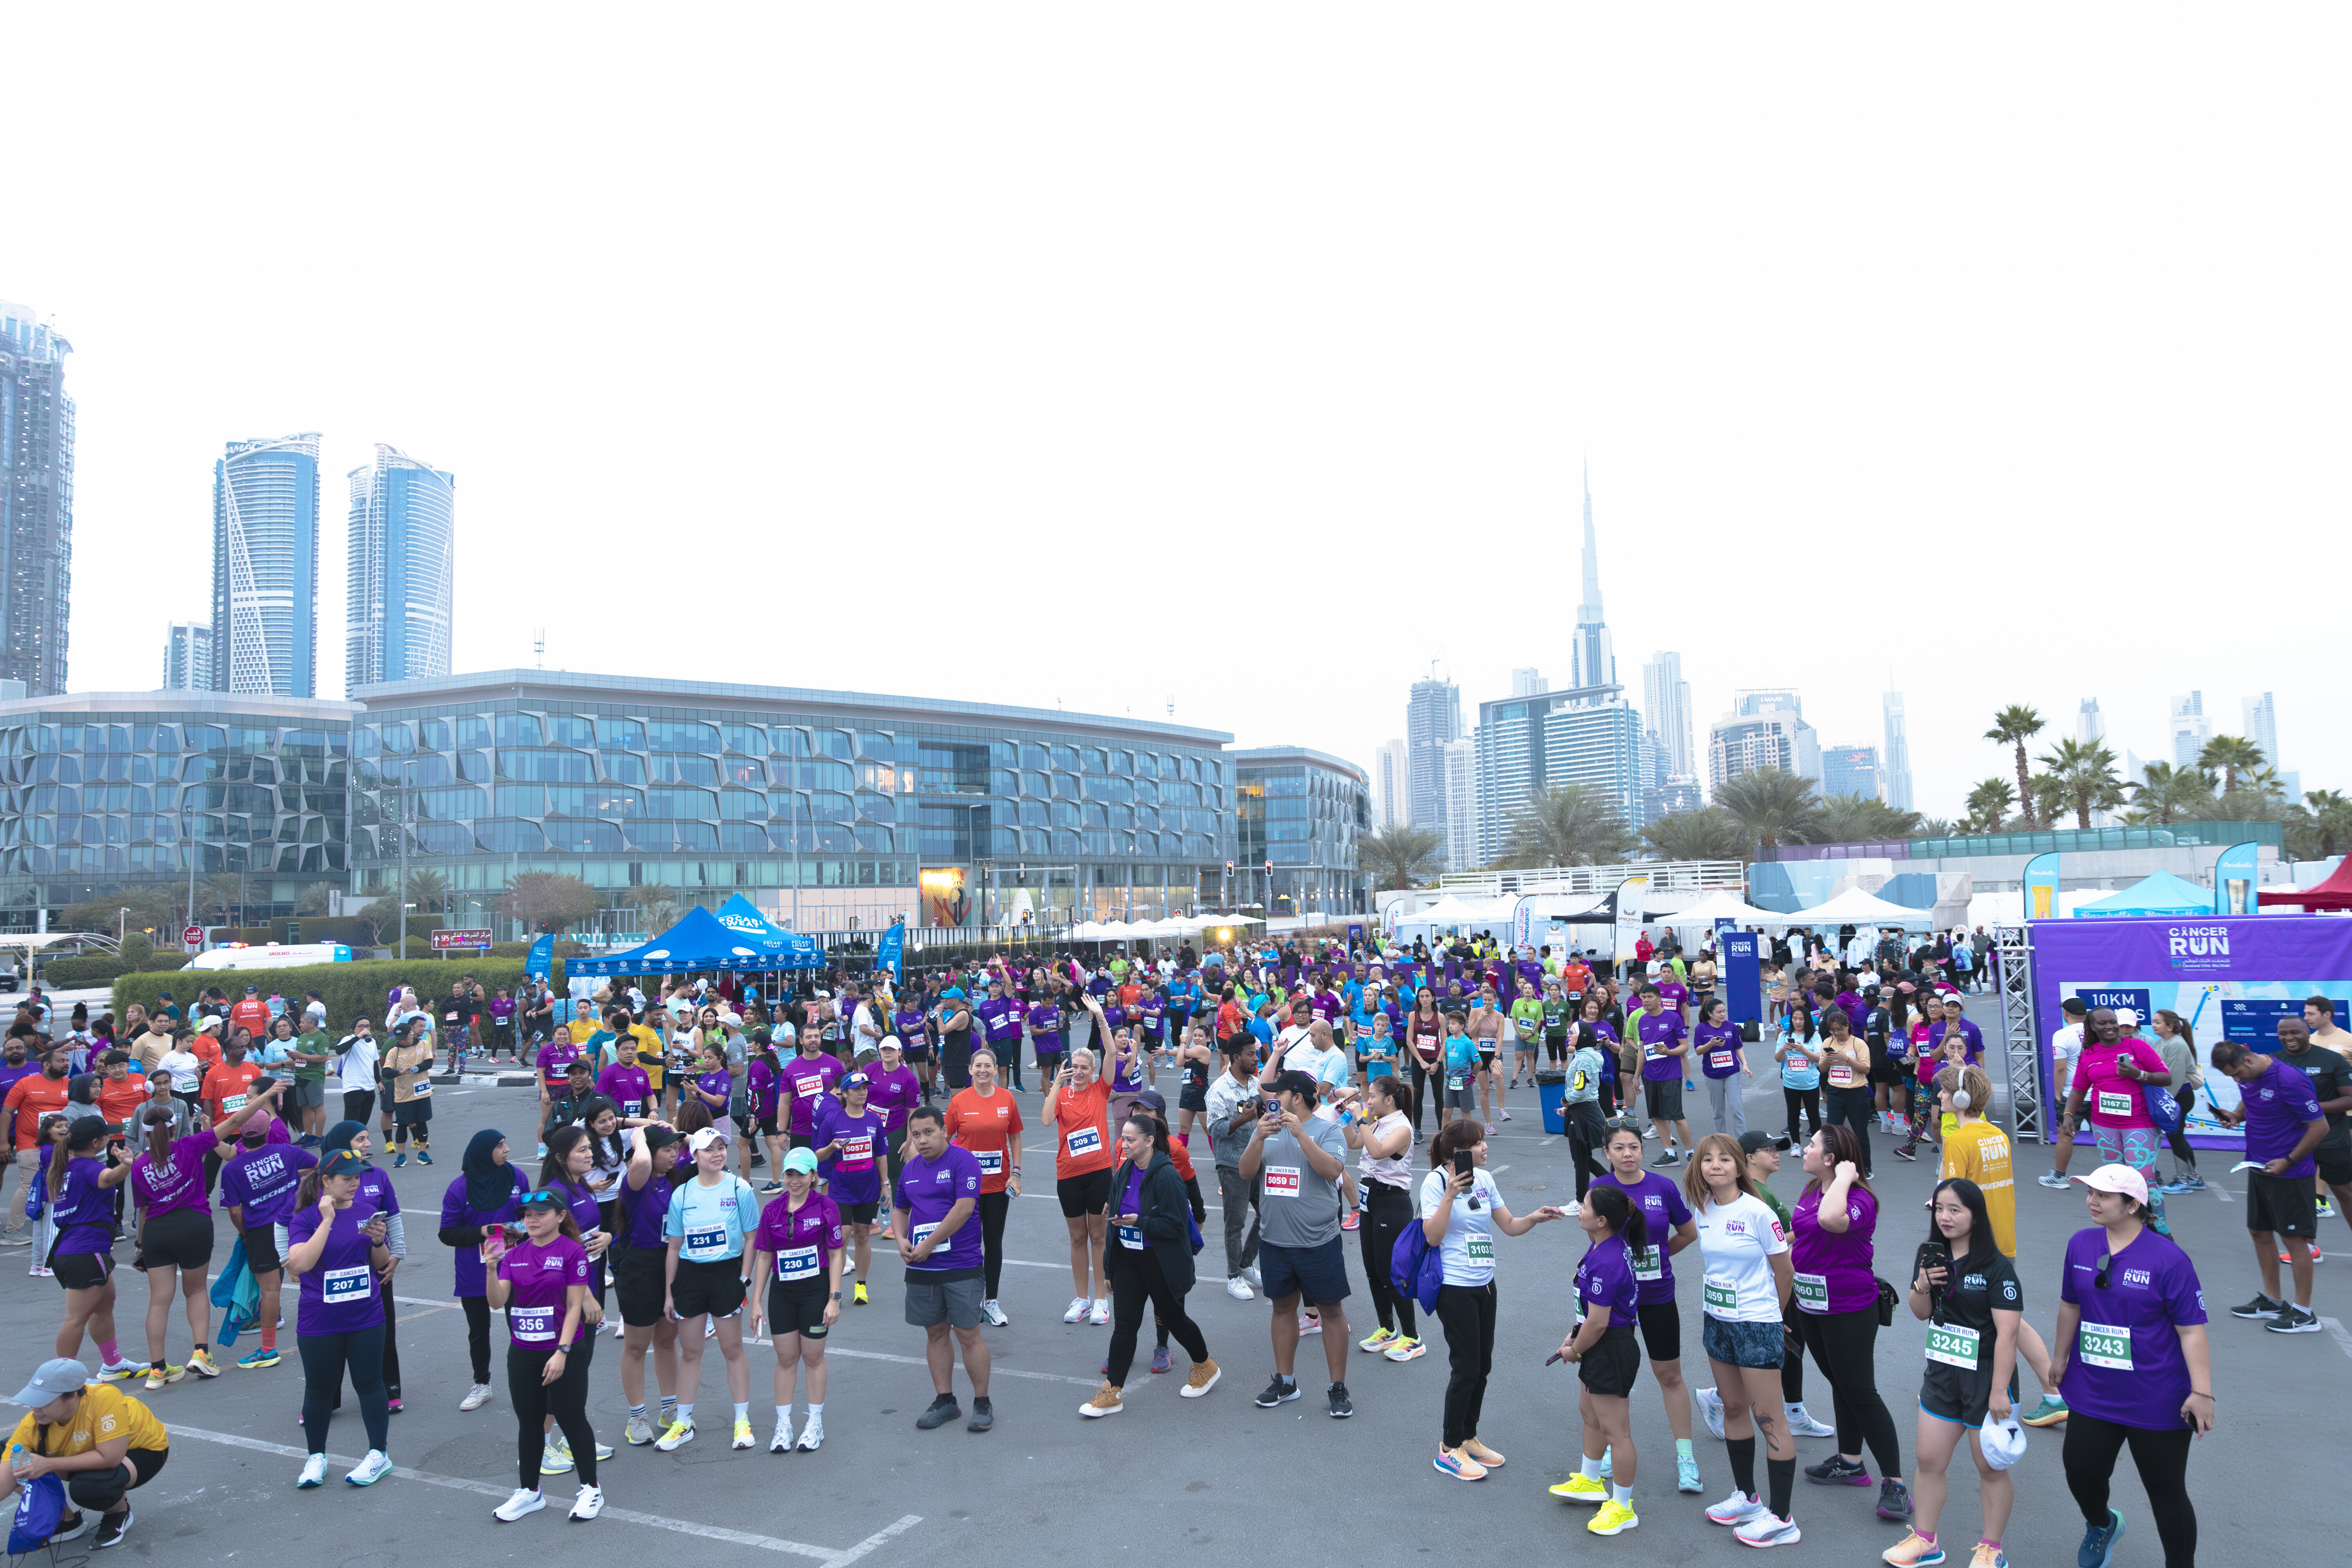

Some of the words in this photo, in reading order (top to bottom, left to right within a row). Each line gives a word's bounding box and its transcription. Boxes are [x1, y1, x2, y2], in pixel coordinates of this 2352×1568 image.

[718, 916, 763, 925] POCARI
[2169, 927, 2228, 936] CANCER
[2170, 937, 2229, 955] RUN
[2092, 994, 2136, 1005] 10KM
[227, 1100, 246, 1108] 3294
[1073, 1138, 1088, 1147] 209
[1977, 1134, 2005, 1147] CANCER
[1980, 1143, 2009, 1162] RUN
[145, 1163, 177, 1185] RUN
[246, 1158, 285, 1180] RUN
[1268, 1175, 1287, 1185] 5059
[249, 1179, 298, 1207] SKECHERS
[1120, 1228, 1127, 1237] 81
[1726, 1223, 1745, 1232] RUN
[693, 1236, 710, 1245] 231
[1471, 1245, 1489, 1255] 3103
[784, 1259, 802, 1269] 230
[340, 1269, 359, 1277] CANCER
[2125, 1267, 2150, 1276] CANCER
[1710, 1278, 1722, 1287] CANCER
[1964, 1276, 1987, 1285] RUN
[2123, 1272, 2150, 1285] RUN
[332, 1280, 355, 1292] 207
[1706, 1288, 1723, 1302] 3059
[519, 1318, 544, 1330] 356
[1941, 1325, 1961, 1334] CANCER
[1962, 1328, 1974, 1336] RUN
[2091, 1325, 2111, 1334] CANCER
[1931, 1332, 1973, 1356] 3245
[2084, 1336, 2124, 1356] 3243
[101, 1413, 114, 1422] plan
